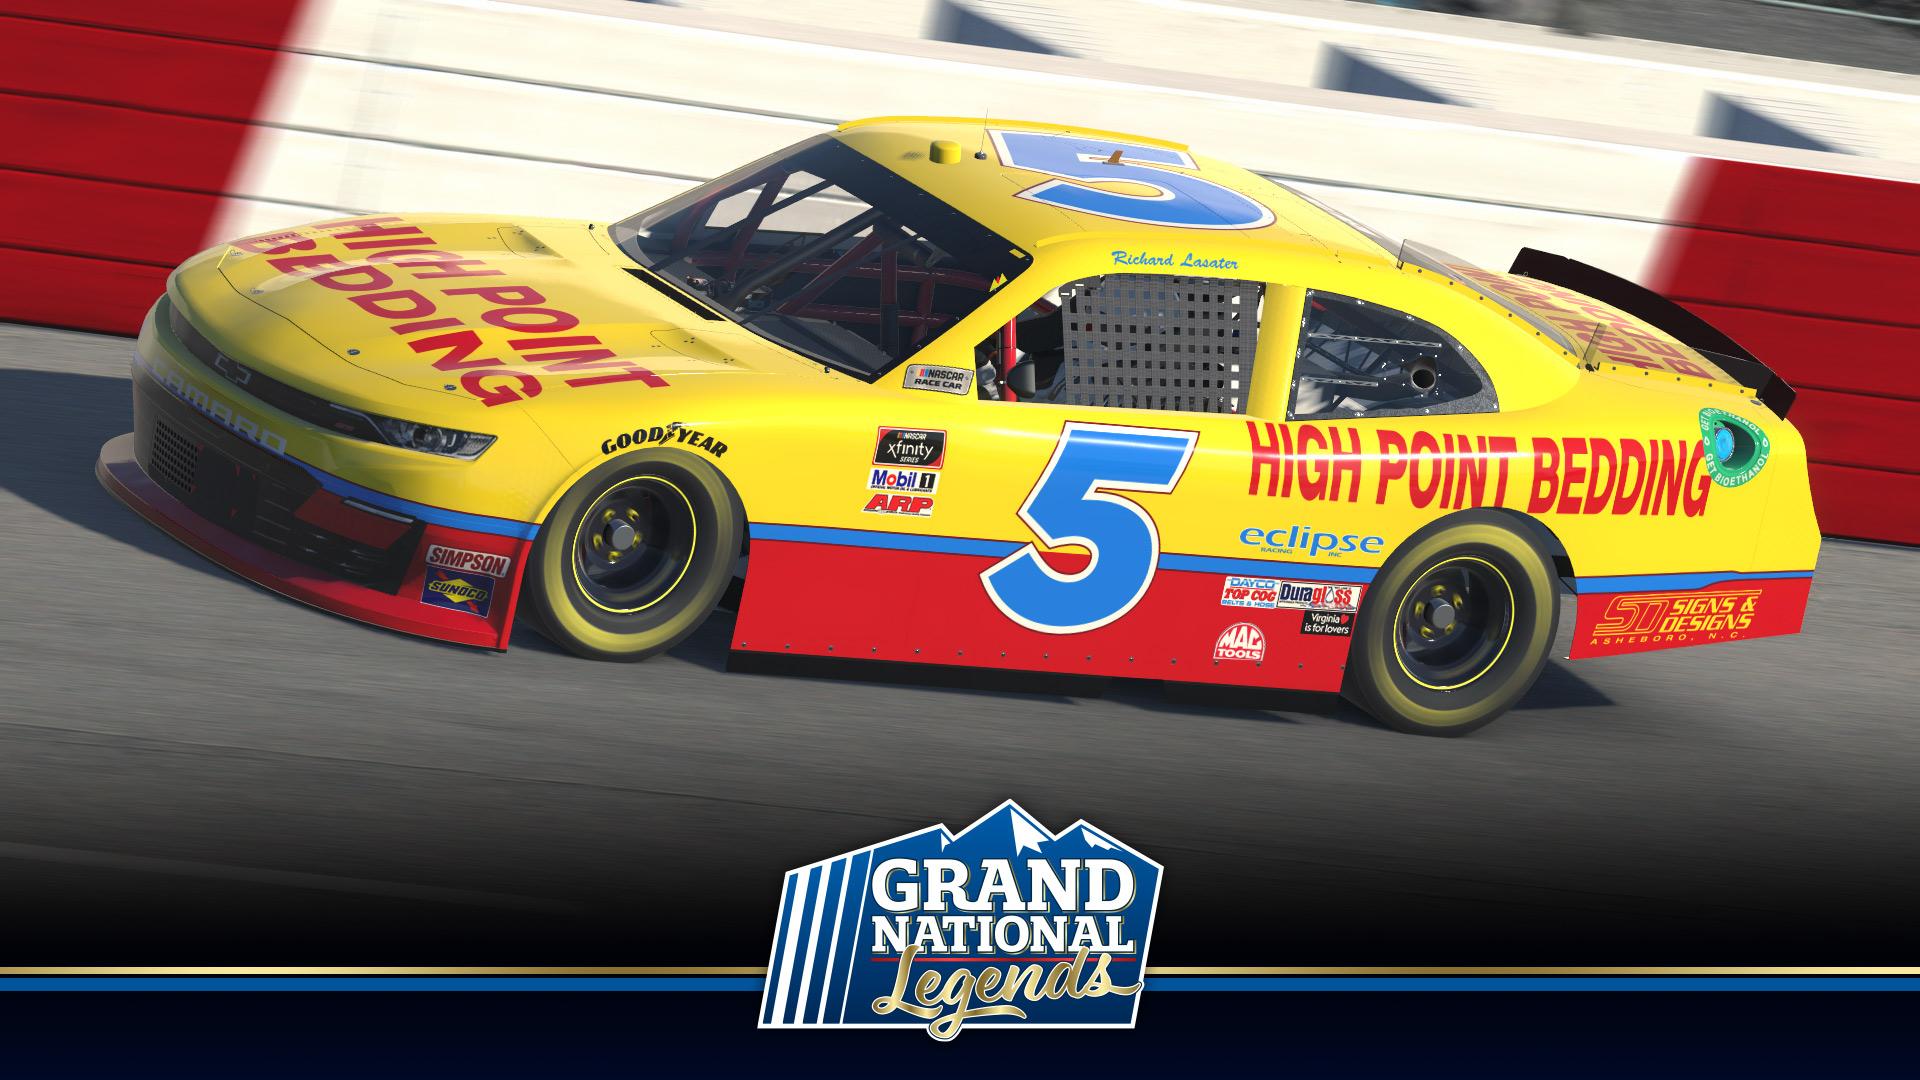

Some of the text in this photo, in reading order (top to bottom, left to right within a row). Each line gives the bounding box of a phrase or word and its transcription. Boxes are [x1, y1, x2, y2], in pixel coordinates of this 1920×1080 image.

[985, 129, 1276, 230] 5
[1112, 250, 1238, 269] Richard Lasater
[312, 217, 671, 390] HIGH POINT
[229, 231, 543, 407] BEDDING
[914, 378, 962, 389] RACE CAR
[926, 368, 964, 381] NASCAR
[150, 358, 288, 455] CAMARO
[902, 432, 927, 440] NASCAR
[887, 440, 934, 460] xfinity
[871, 469, 918, 487] Mobil
[1246, 420, 1712, 517] HIGH POINT BEDDING
[1706, 453, 1769, 486] GET BIOETHANOL
[865, 494, 934, 512] ARP
[980, 420, 1199, 634] 5
[1240, 525, 1384, 556] eclipse
[430, 547, 506, 576] SIMPSON
[431, 581, 488, 600] SUNOCO
[1229, 578, 1276, 589] DAYCO
[1221, 599, 1245, 607] BELTS
[1224, 588, 1250, 600] TOP
[1670, 596, 1758, 615] SIGNS &
[1305, 622, 1349, 634] is for lovers
[1312, 613, 1340, 624] Virginia
[1659, 613, 1755, 633] DESIGNS
[1219, 626, 1262, 649] MAC
[1217, 648, 1261, 659] TOOLS
